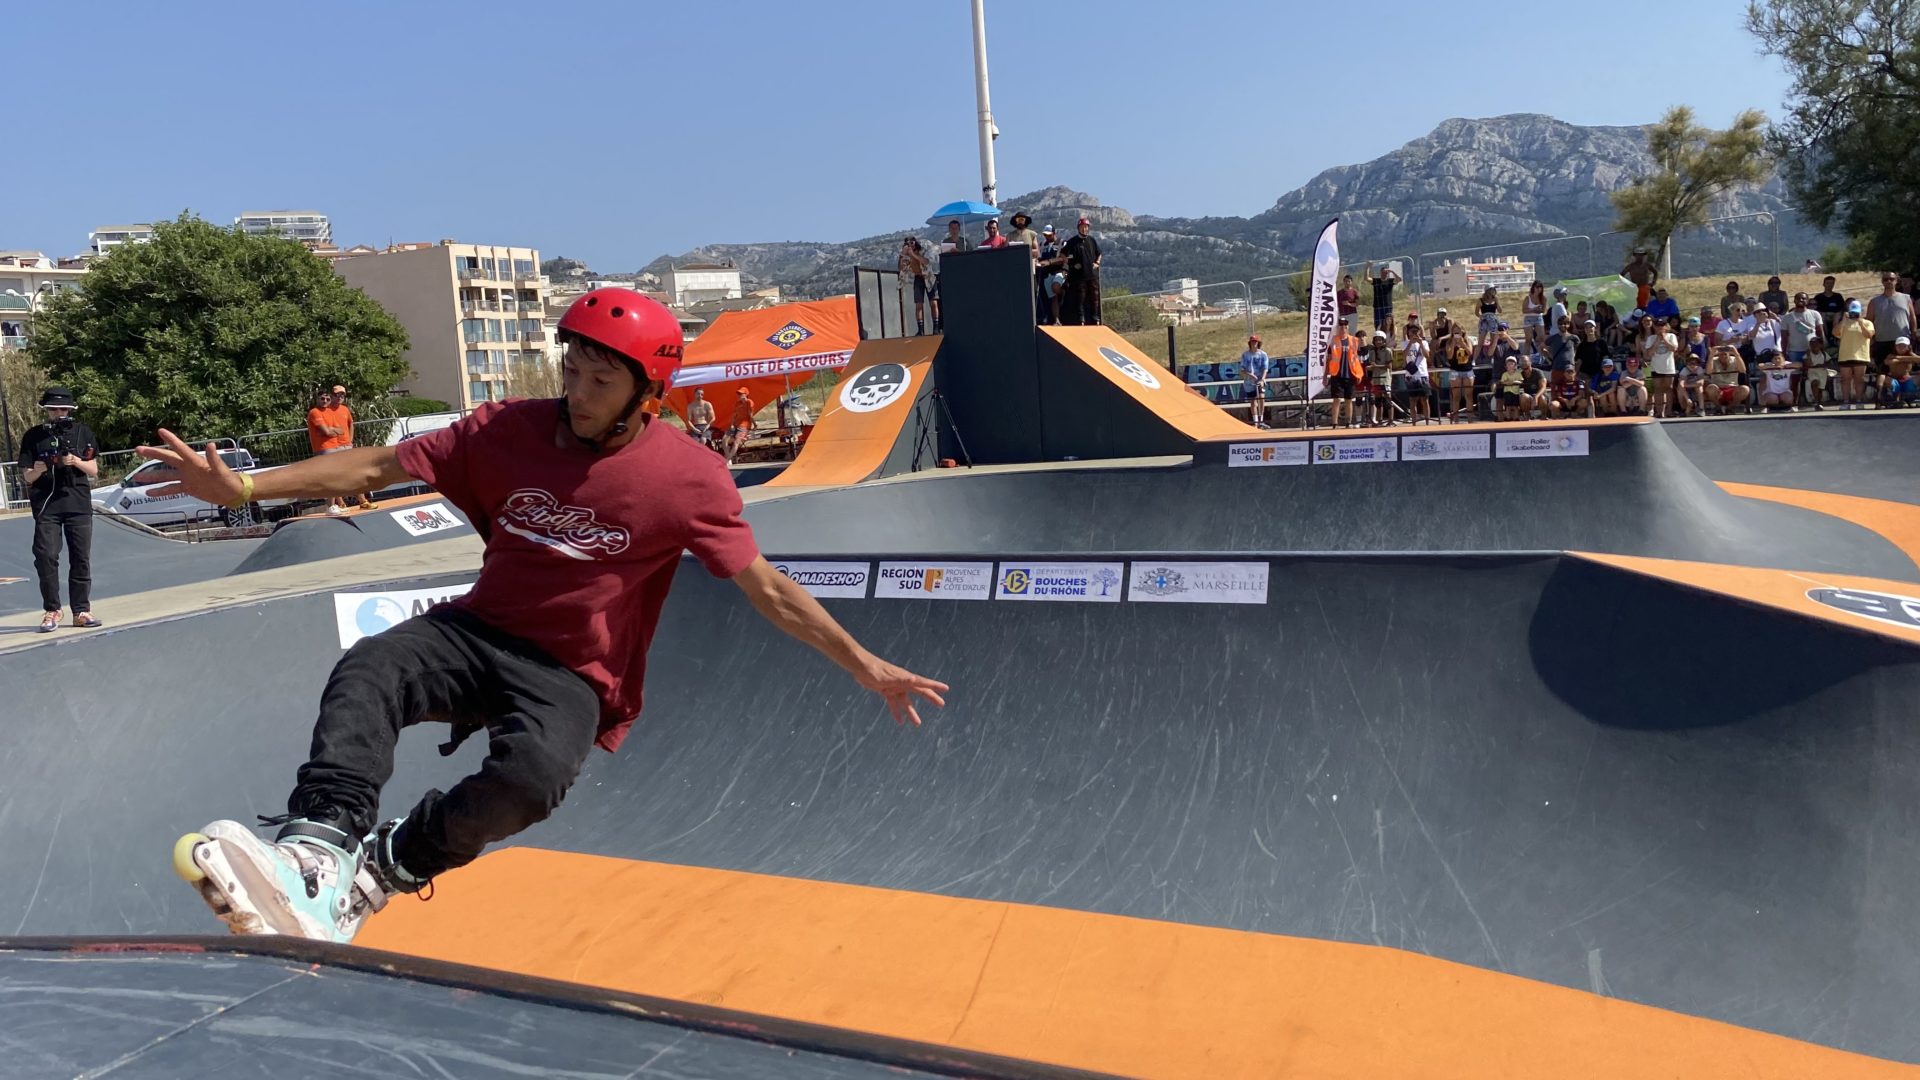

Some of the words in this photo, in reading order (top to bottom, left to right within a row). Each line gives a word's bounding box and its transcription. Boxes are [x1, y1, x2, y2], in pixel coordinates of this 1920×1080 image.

[1313, 280, 1322, 319] ACTION
[1310, 325, 1318, 368] SPORTS
[725, 361, 764, 378] POSTE
[768, 360, 784, 372] DE
[787, 352, 845, 370] SECOURS
[945, 568, 980, 576] PROVENCE
[898, 580, 922, 590] SUD
[1009, 573, 1025, 591] 13
[1035, 577, 1087, 586] BOUCHES
[1192, 580, 1265, 591] MARSEILLE
